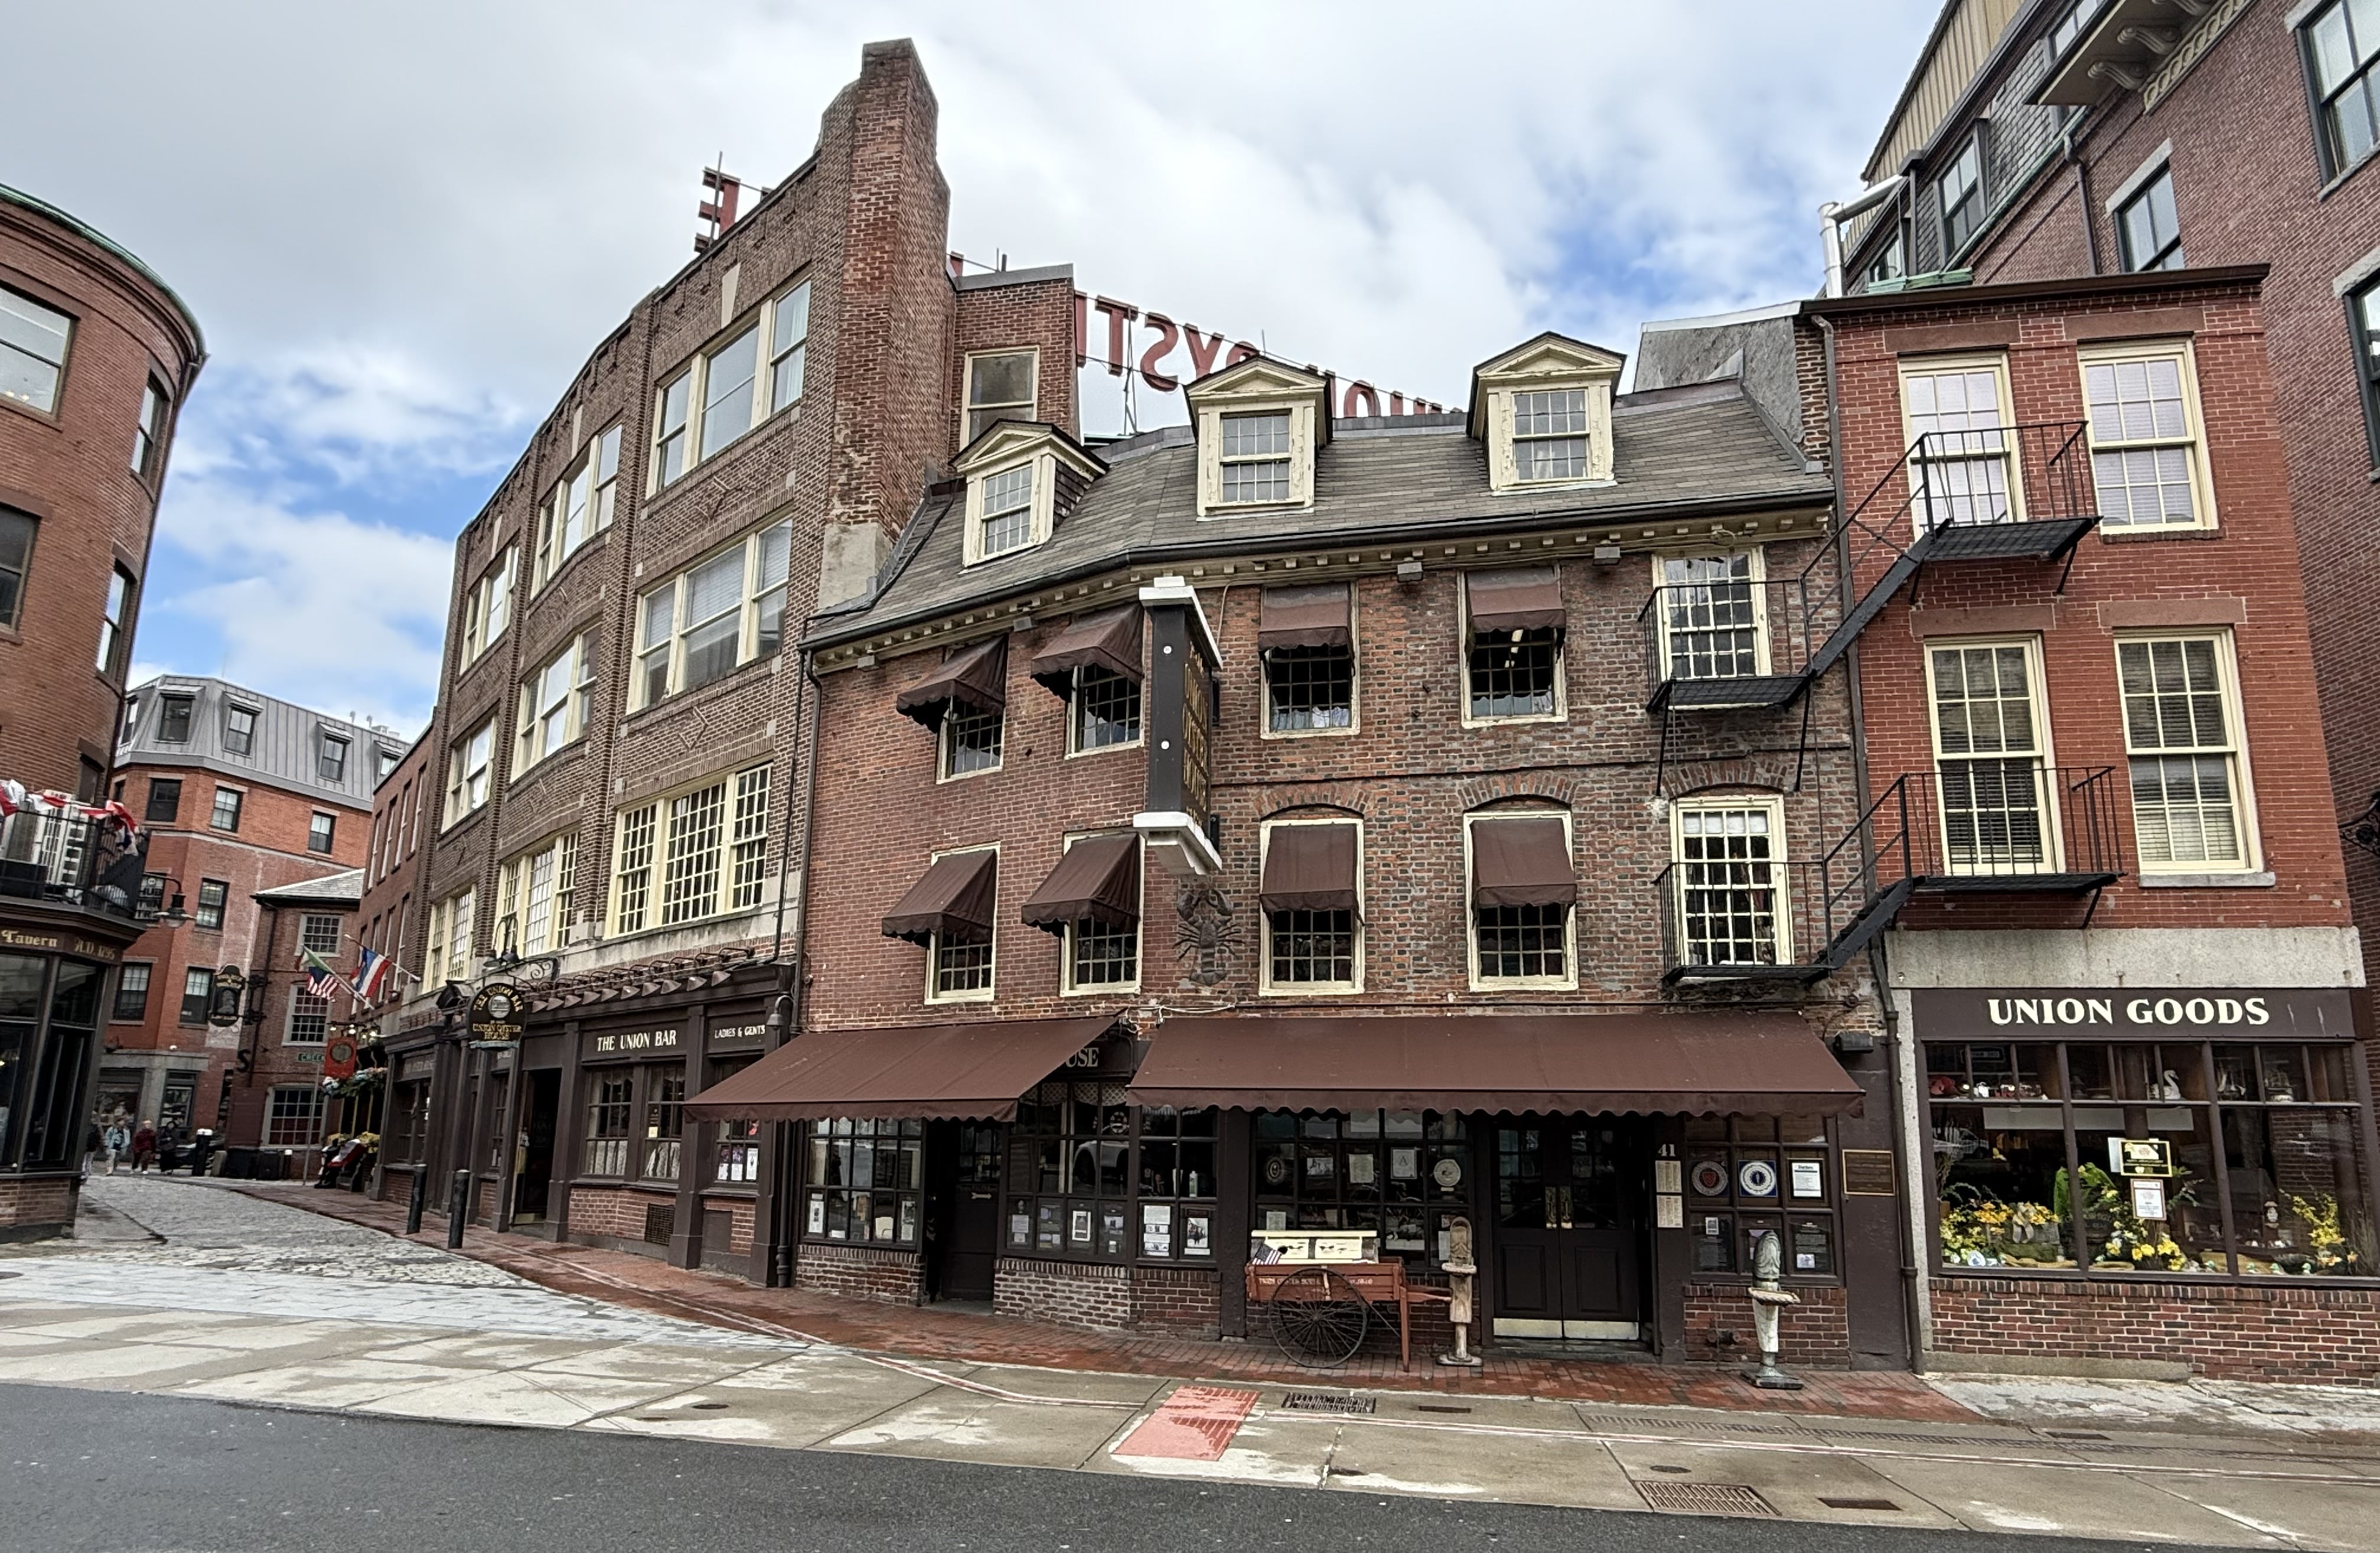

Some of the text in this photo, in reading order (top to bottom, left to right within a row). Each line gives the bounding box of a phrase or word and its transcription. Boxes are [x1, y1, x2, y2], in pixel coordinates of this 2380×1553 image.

[2, 930, 58, 947] Tavern
[485, 985, 513, 997] UNION
[1988, 997, 2270, 1025] UNION GOODS
[715, 1024, 765, 1039] LADIES & GENTS
[597, 1030, 677, 1052] THE UNION BAR
[1065, 1047, 1100, 1067] USE
[1658, 1144, 1676, 1157] 41
